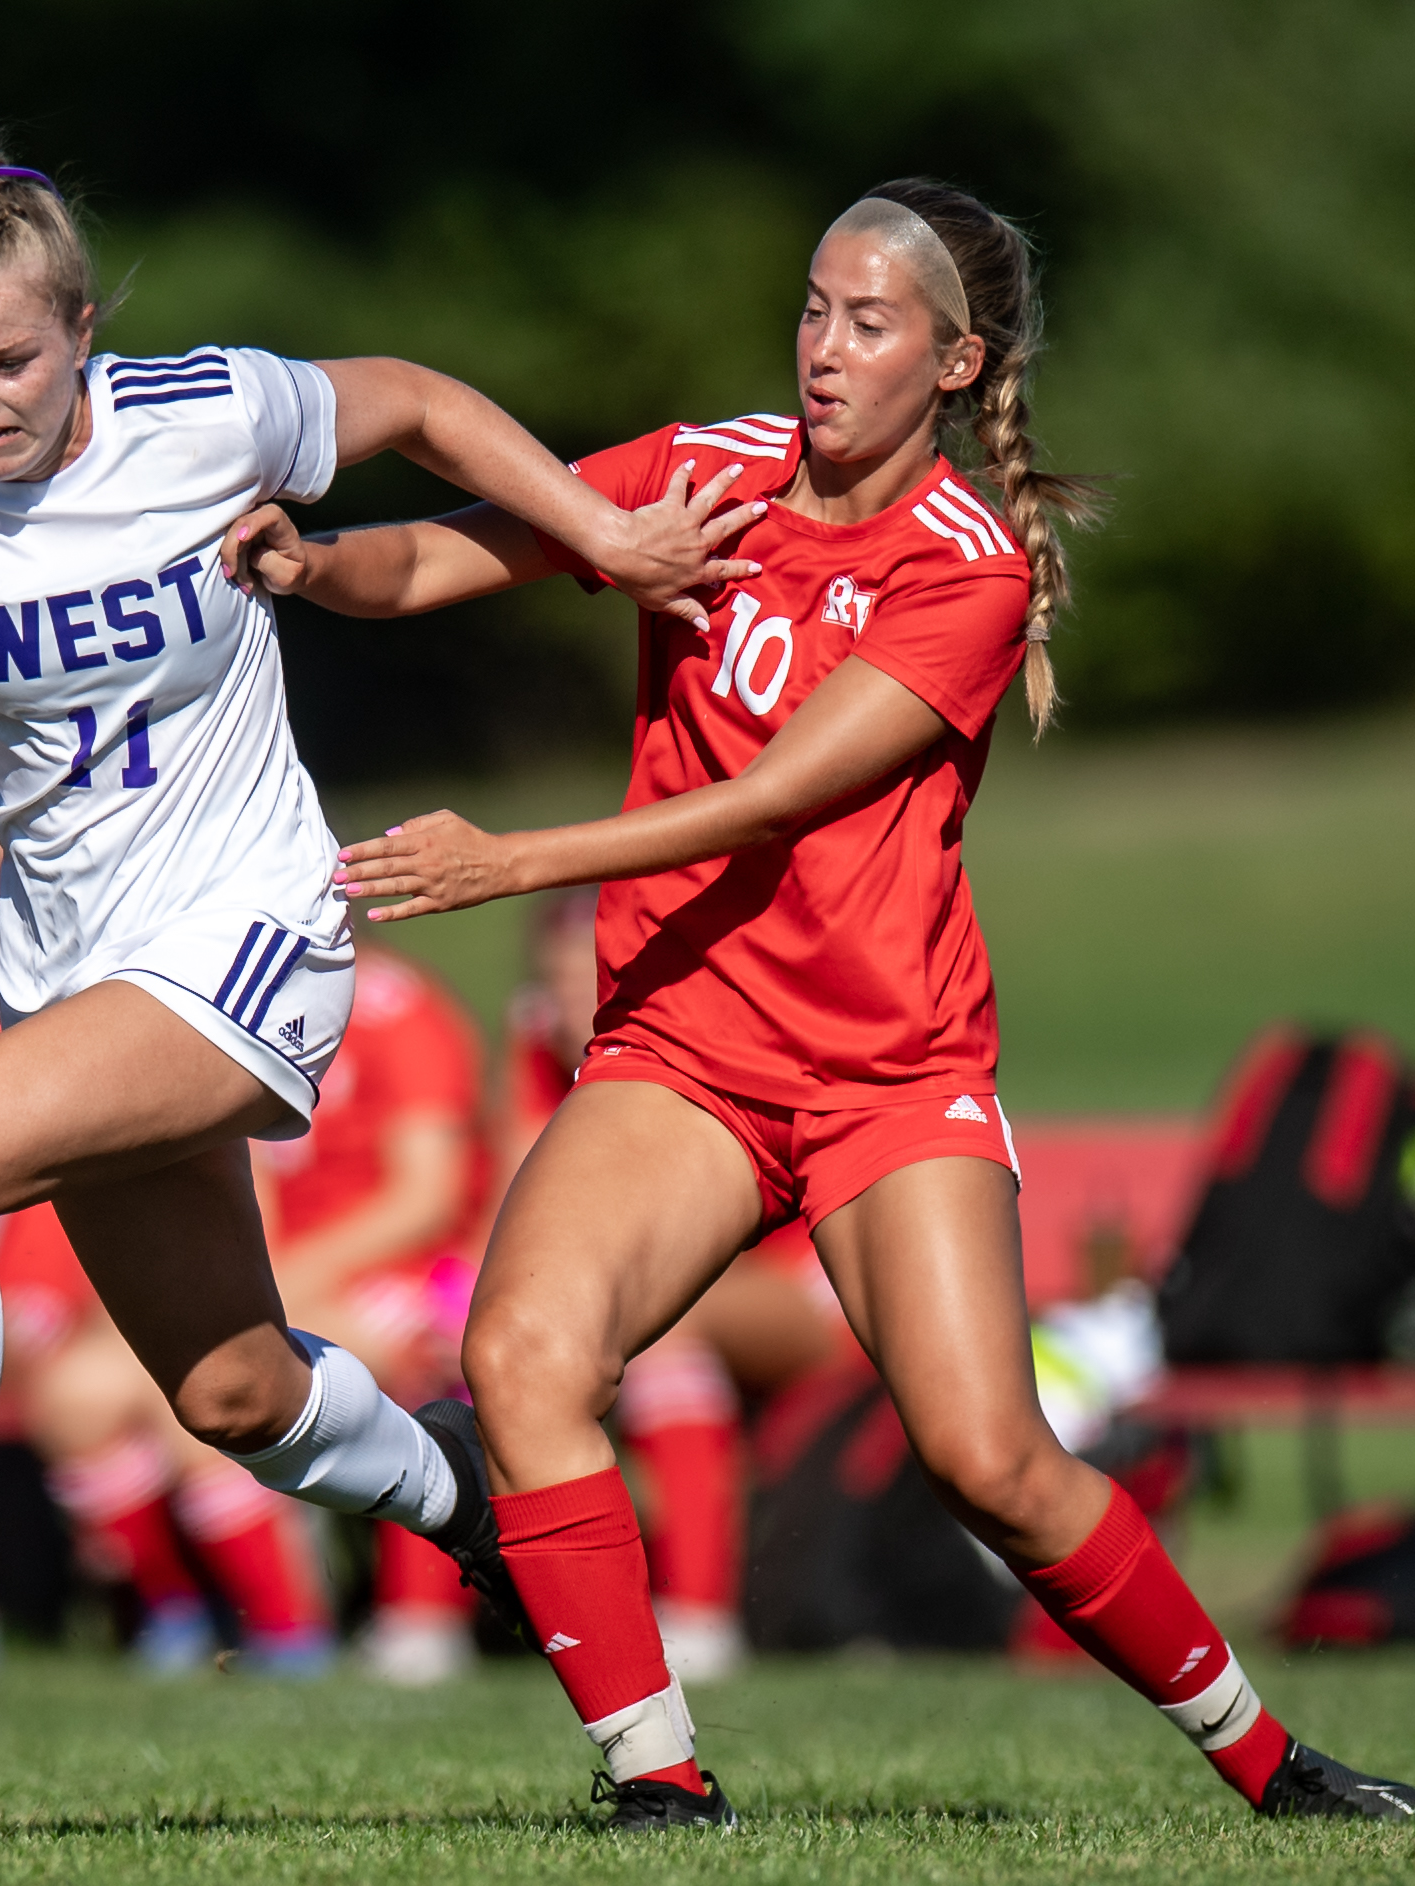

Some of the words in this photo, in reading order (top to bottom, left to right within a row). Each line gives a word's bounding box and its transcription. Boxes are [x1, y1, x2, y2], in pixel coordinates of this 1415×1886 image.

[710, 590, 794, 717] 10
[57, 698, 158, 789] 11
[278, 1026, 305, 1053] adidas
[944, 1109, 988, 1124] adidas
